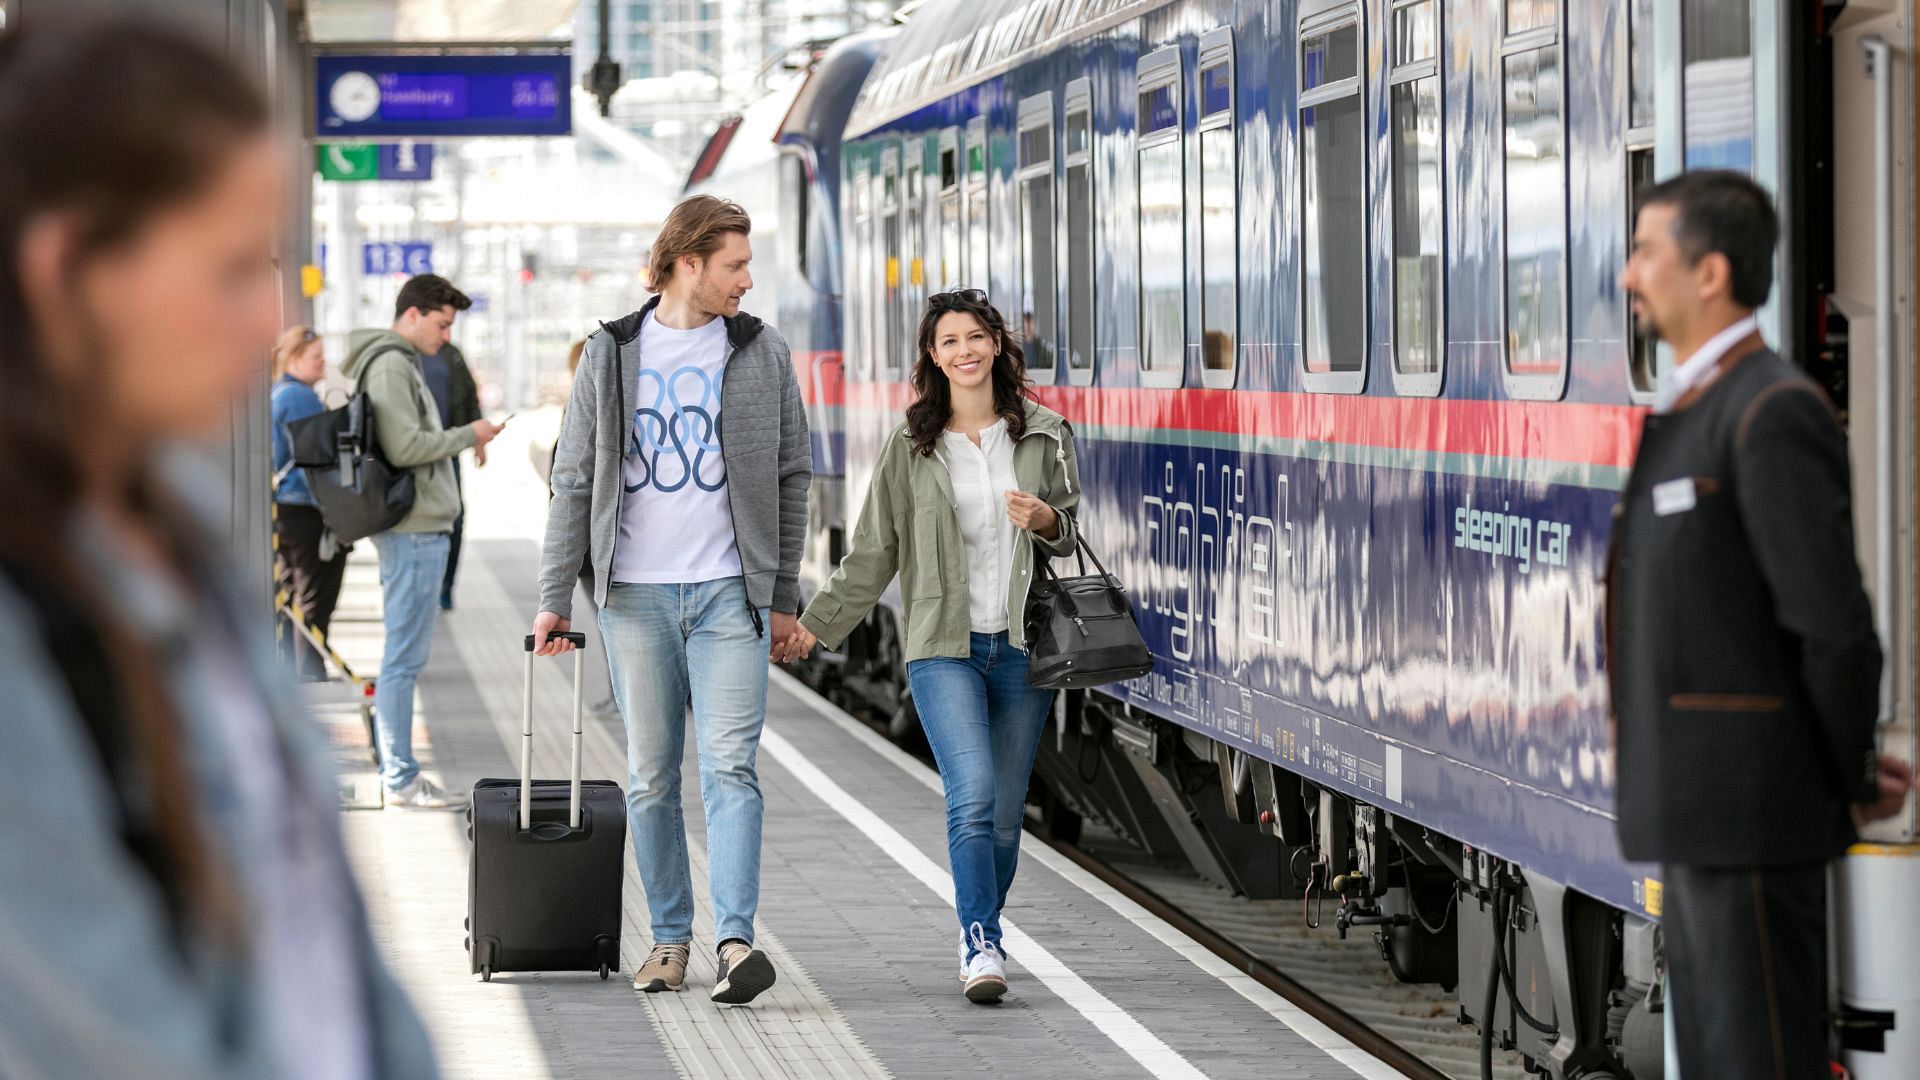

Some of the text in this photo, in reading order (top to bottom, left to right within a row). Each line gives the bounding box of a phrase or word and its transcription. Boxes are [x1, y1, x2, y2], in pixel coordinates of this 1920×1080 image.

[1141, 460, 1292, 678] nightjet
[1454, 493, 1571, 574] sleeping car
